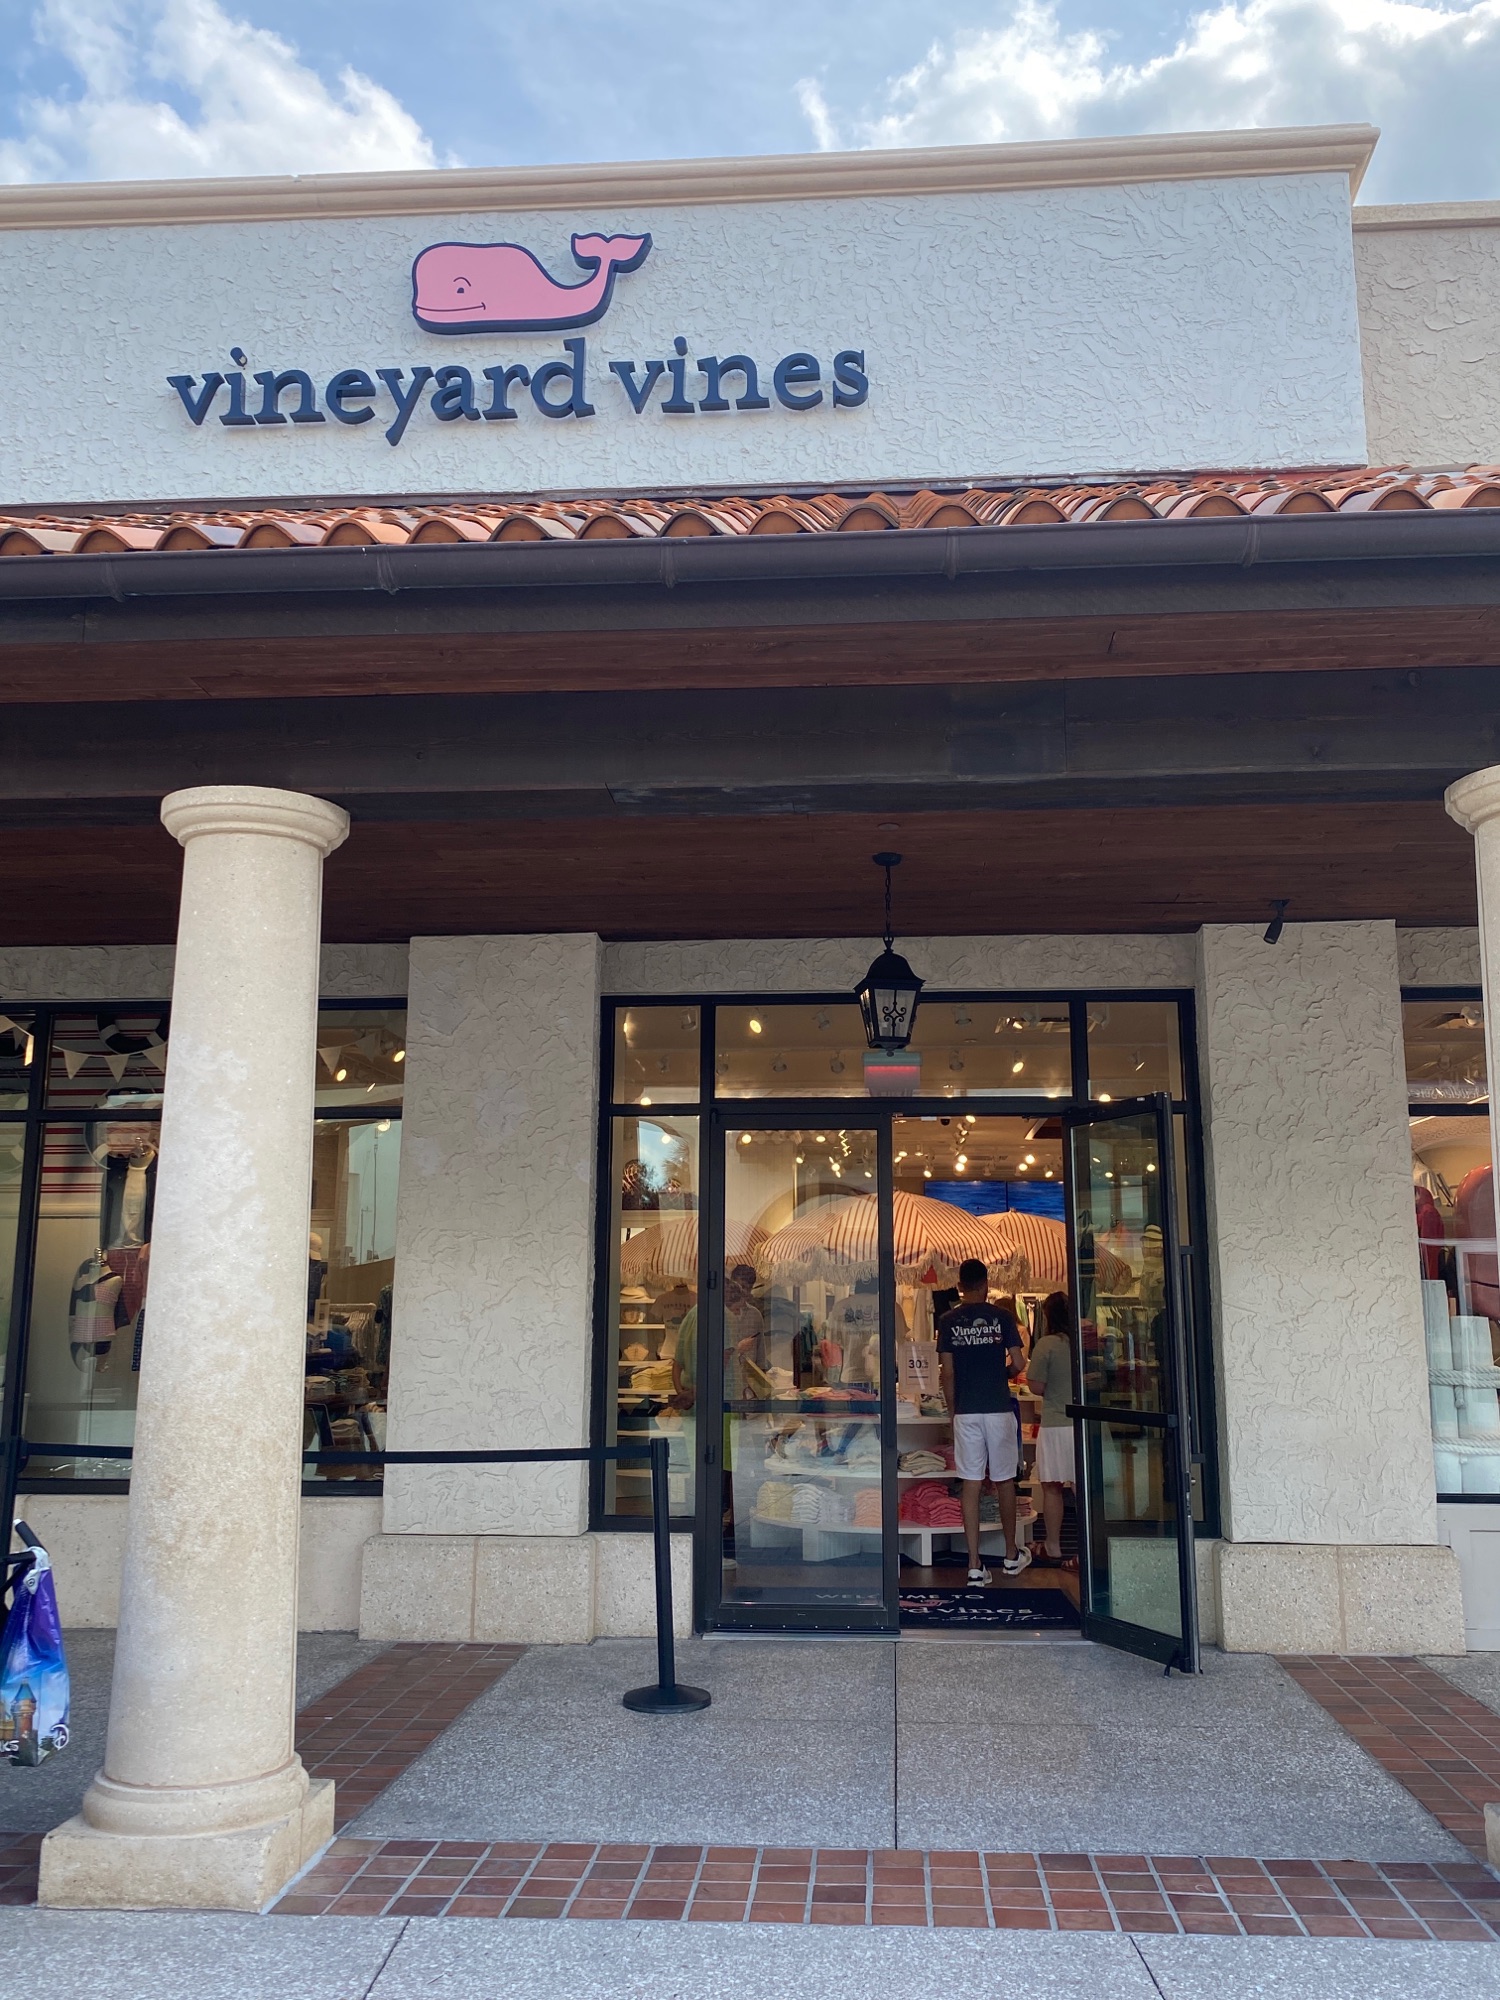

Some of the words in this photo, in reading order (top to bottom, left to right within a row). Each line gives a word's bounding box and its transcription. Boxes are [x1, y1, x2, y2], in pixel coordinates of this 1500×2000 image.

[167, 337, 595, 446] vineyard
[609, 336, 869, 415] vines
[951, 1324, 1002, 1336] Vineyard
[964, 1335, 994, 1345] Vines
